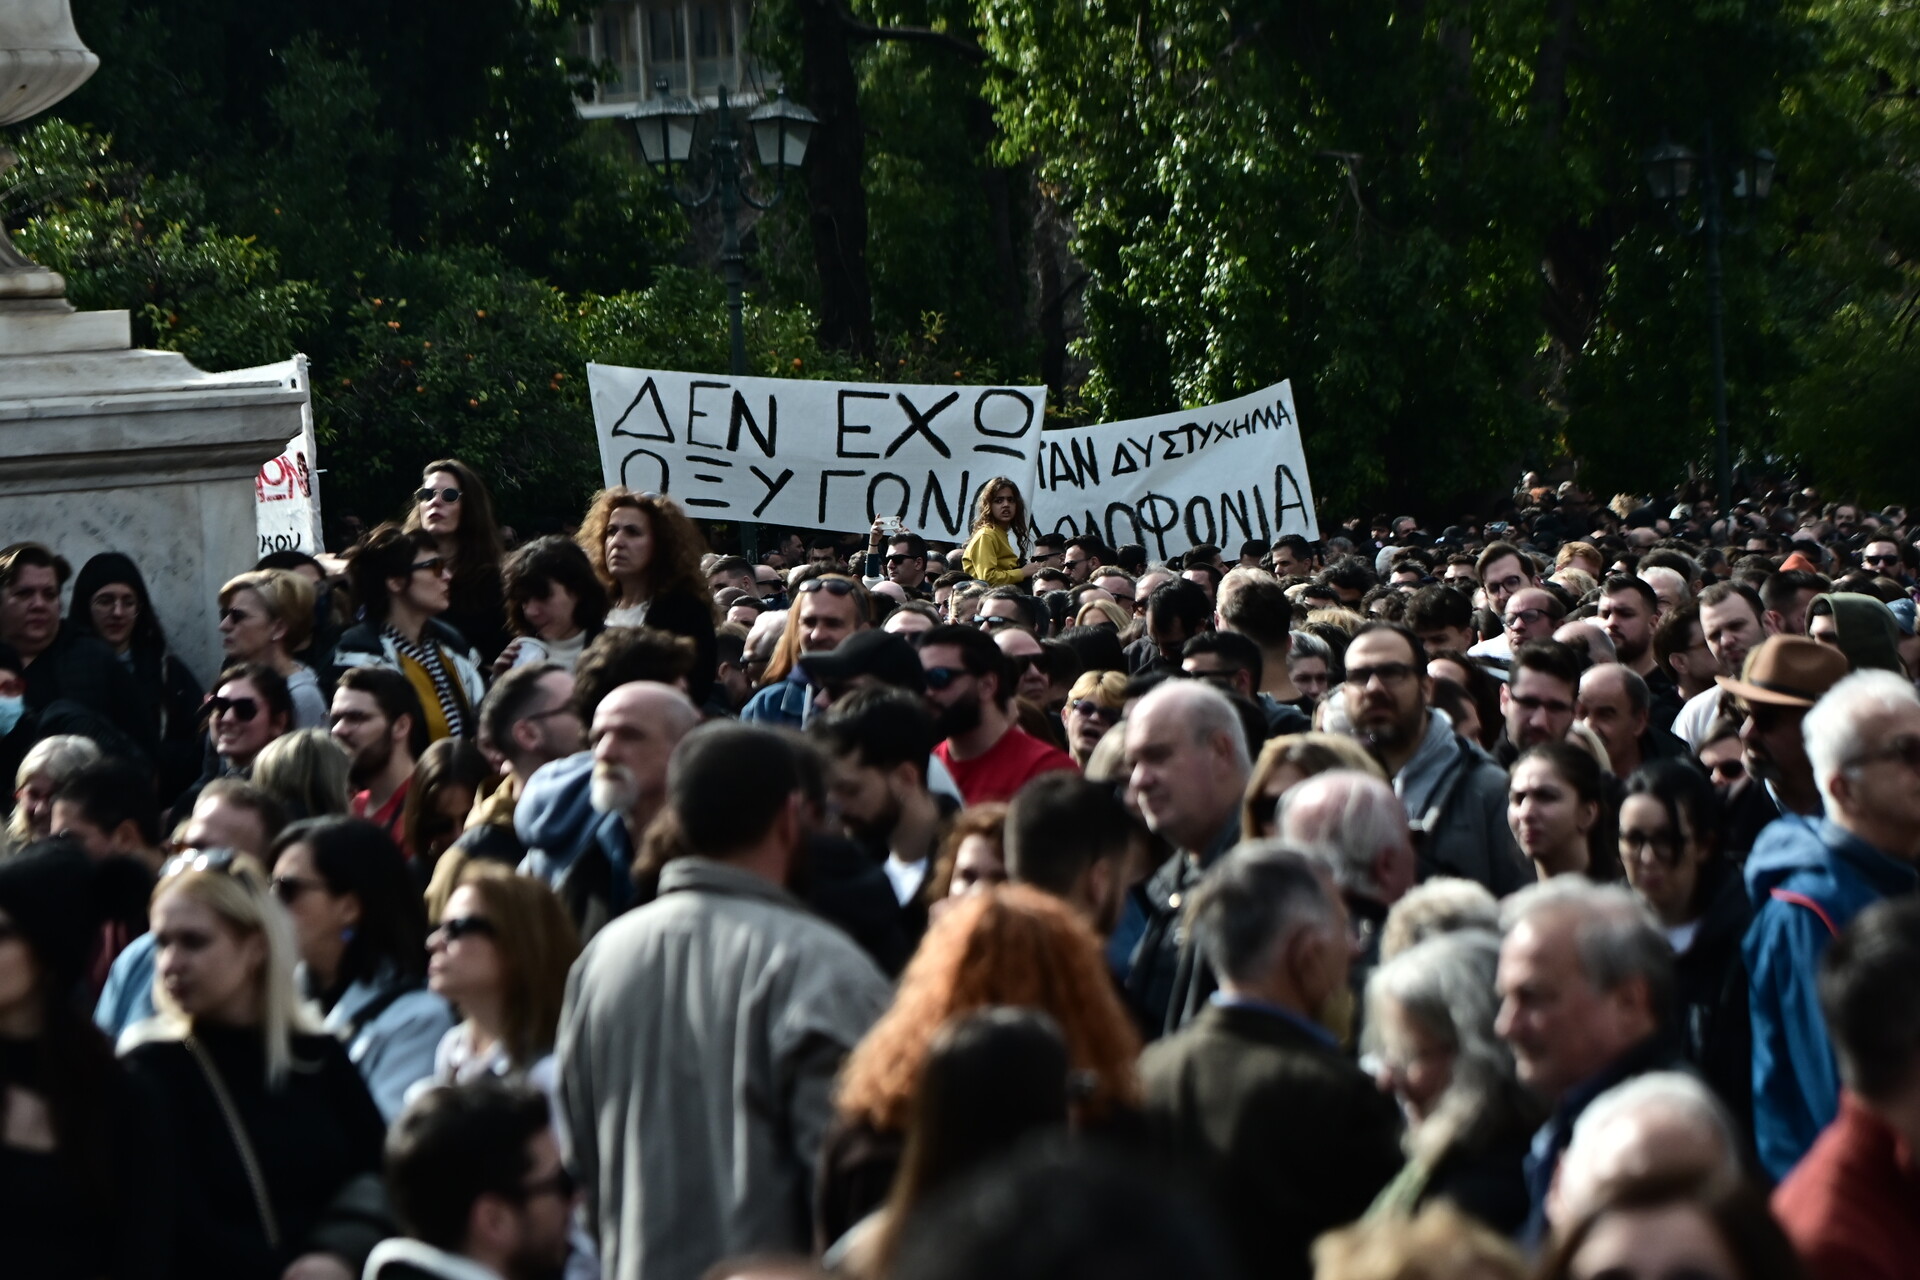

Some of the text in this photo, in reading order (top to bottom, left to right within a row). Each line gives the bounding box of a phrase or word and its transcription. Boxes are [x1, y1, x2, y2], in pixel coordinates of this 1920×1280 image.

[611, 376, 1035, 460] ΔΕΝ ΕΧΩ
[1111, 399, 1292, 477] ΔΥΣΤΥΧΗΜΑ
